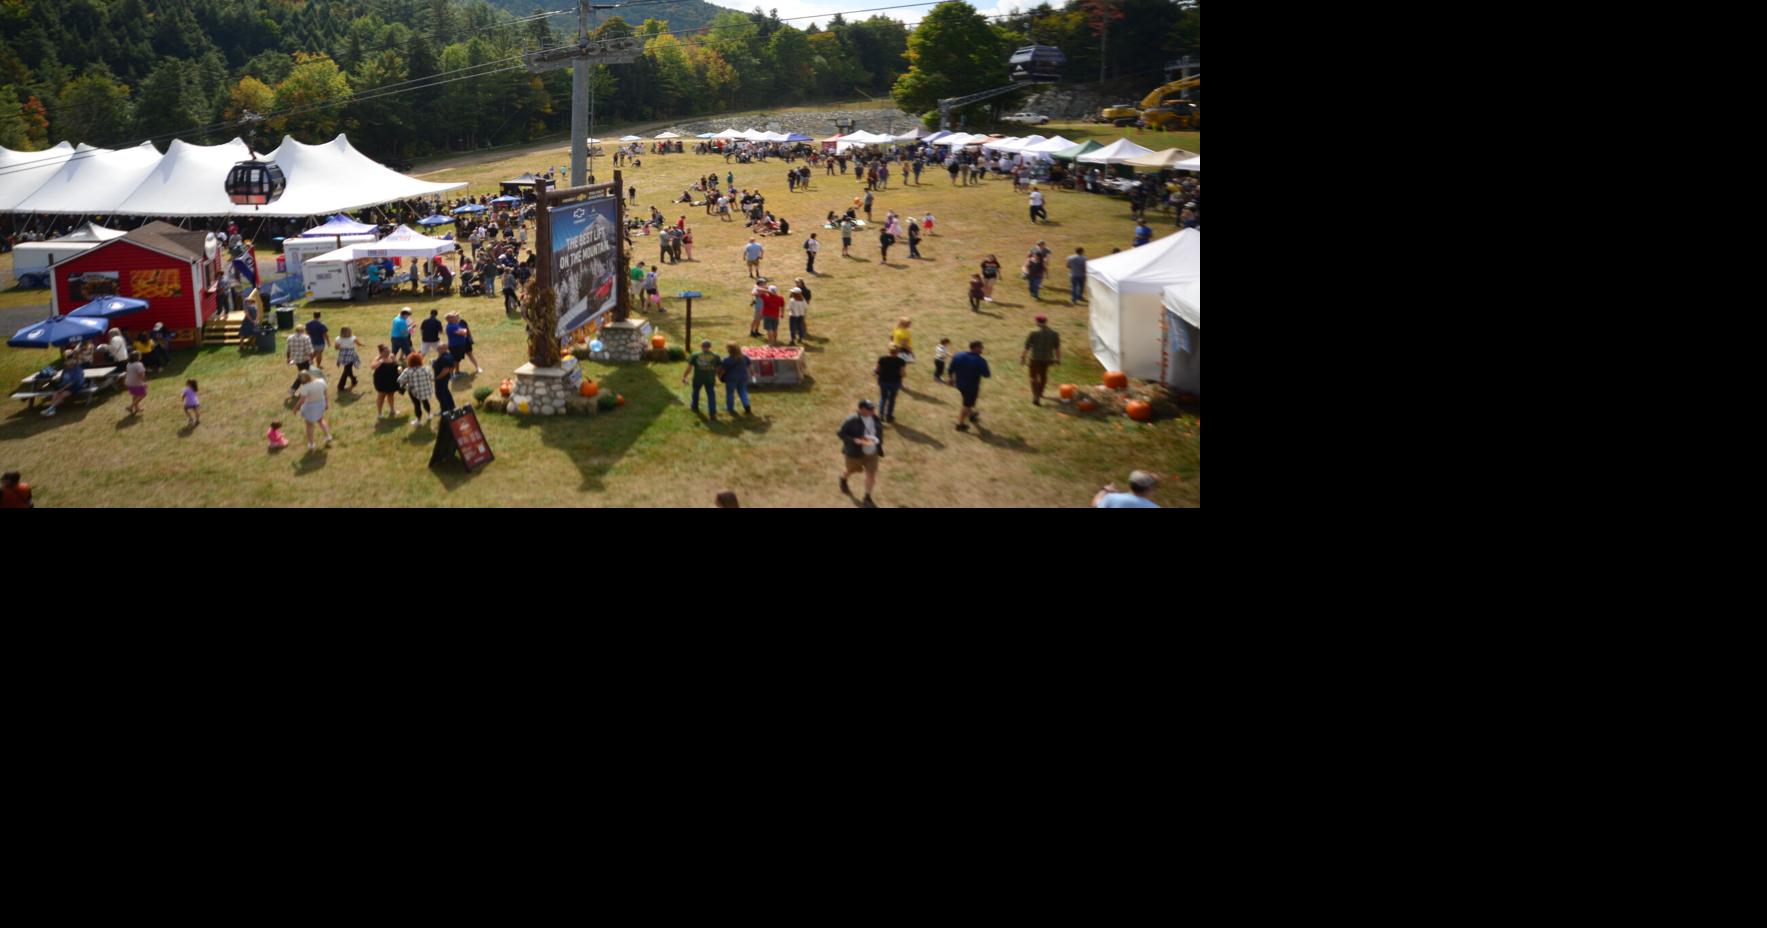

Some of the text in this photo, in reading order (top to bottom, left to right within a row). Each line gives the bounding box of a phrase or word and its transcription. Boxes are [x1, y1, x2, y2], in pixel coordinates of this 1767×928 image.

[566, 236, 578, 251] THE
[579, 231, 593, 246] BEST
[560, 255, 569, 269] ON
[570, 250, 582, 266] THE
